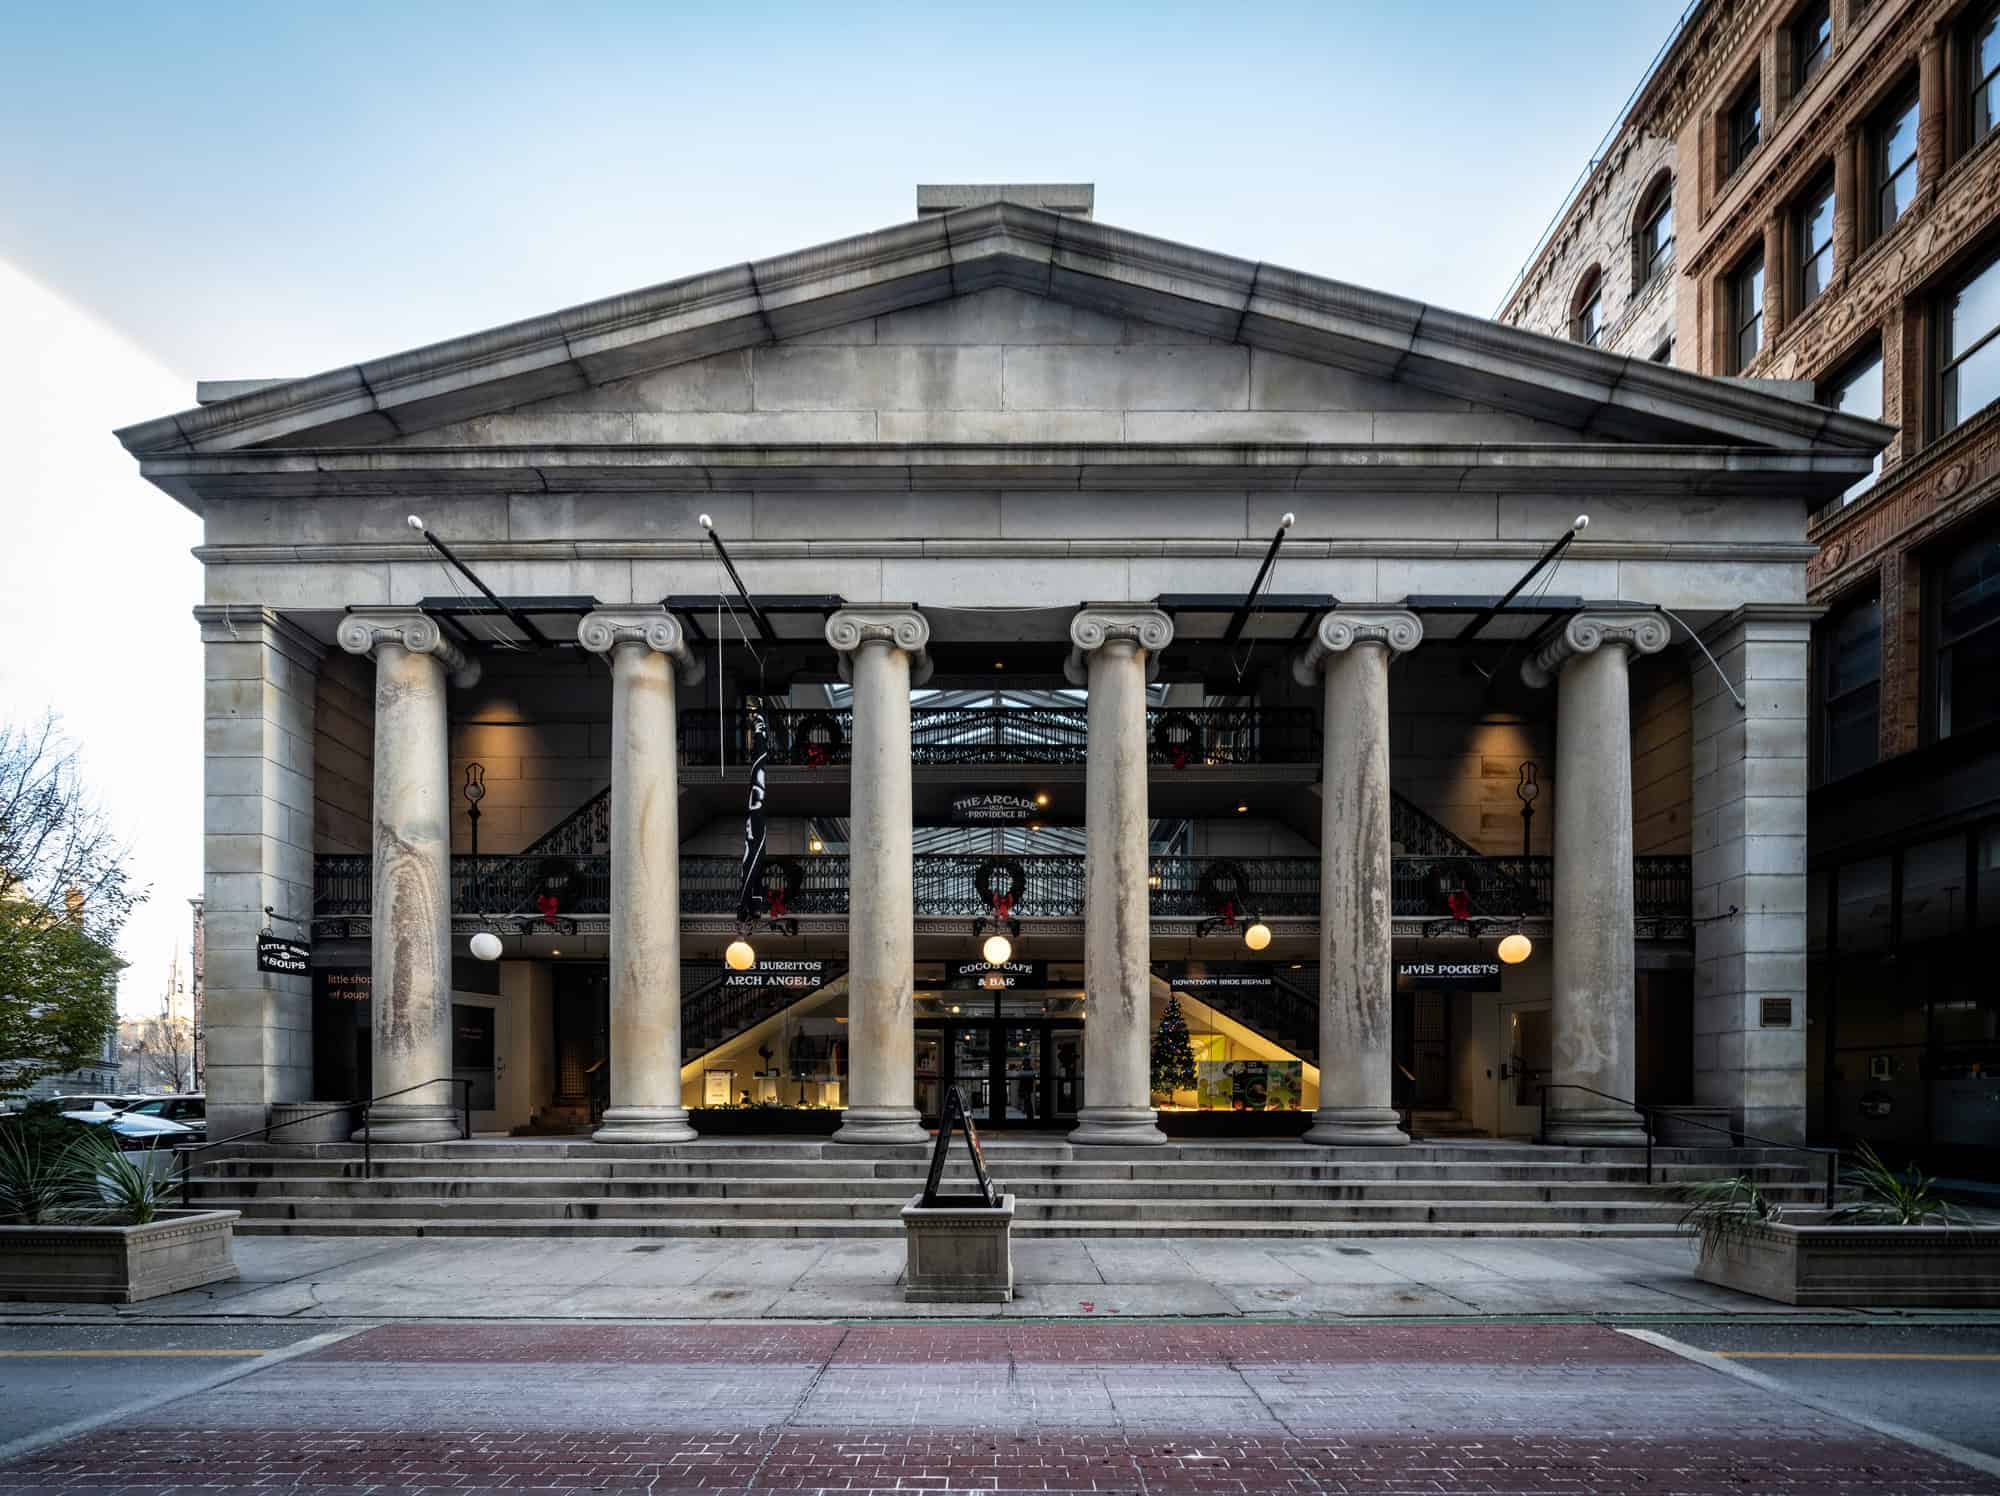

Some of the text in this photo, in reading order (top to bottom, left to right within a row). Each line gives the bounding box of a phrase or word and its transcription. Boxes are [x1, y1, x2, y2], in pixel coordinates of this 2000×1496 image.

[953, 795, 1039, 811] THE ARCADE
[260, 943, 287, 951] LITTLE
[289, 945, 309, 957] SHOP
[269, 957, 306, 970] SOUPS
[760, 961, 822, 970] BURRITOS
[1400, 963, 1499, 975] LIVI'S POCKETS
[328, 975, 349, 984] little
[726, 976, 821, 985] ARCH ANGELS
[990, 978, 1016, 986] BAR
[343, 991, 369, 1001] soups
